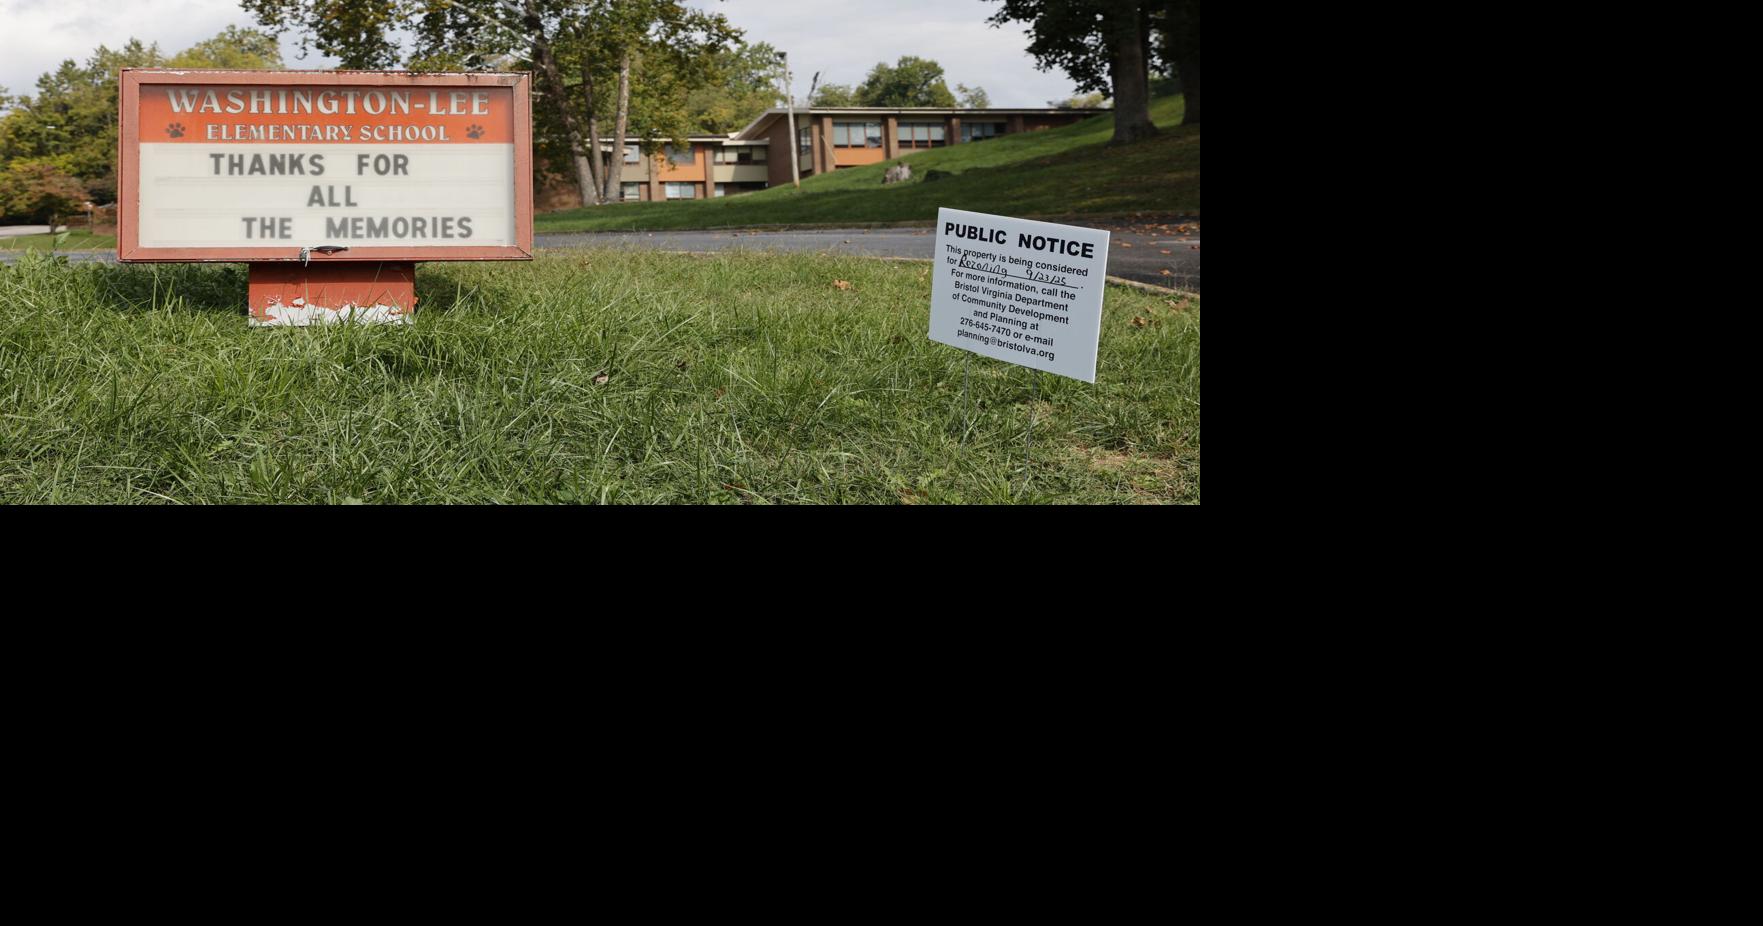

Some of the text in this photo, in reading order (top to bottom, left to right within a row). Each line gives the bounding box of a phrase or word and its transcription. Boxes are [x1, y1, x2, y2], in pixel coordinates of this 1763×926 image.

[166, 89, 489, 115] WASHINGTON-LEE
[207, 124, 449, 141] ELEMENTARY SCHOOL
[209, 153, 409, 176] THANKS FOR
[306, 185, 358, 207] ALL
[241, 216, 473, 239] THE MEMORIES
[945, 222, 1094, 259] PUBLIC NOTICE
[946, 244, 1088, 277] This property is being considered
[946, 256, 957, 265] for
[1026, 269, 1066, 285] 9/23/25
[951, 268, 1076, 300] For more information, call the
[954, 280, 1068, 312] Bristol Virginia Department
[961, 294, 1007, 313] Community
[1008, 304, 1069, 325] Development
[973, 310, 1039, 331] and Planning at
[957, 329, 1055, 362] planning@bristolva.org
[960, 316, 1054, 346] 276-645-7470 or e-mail
